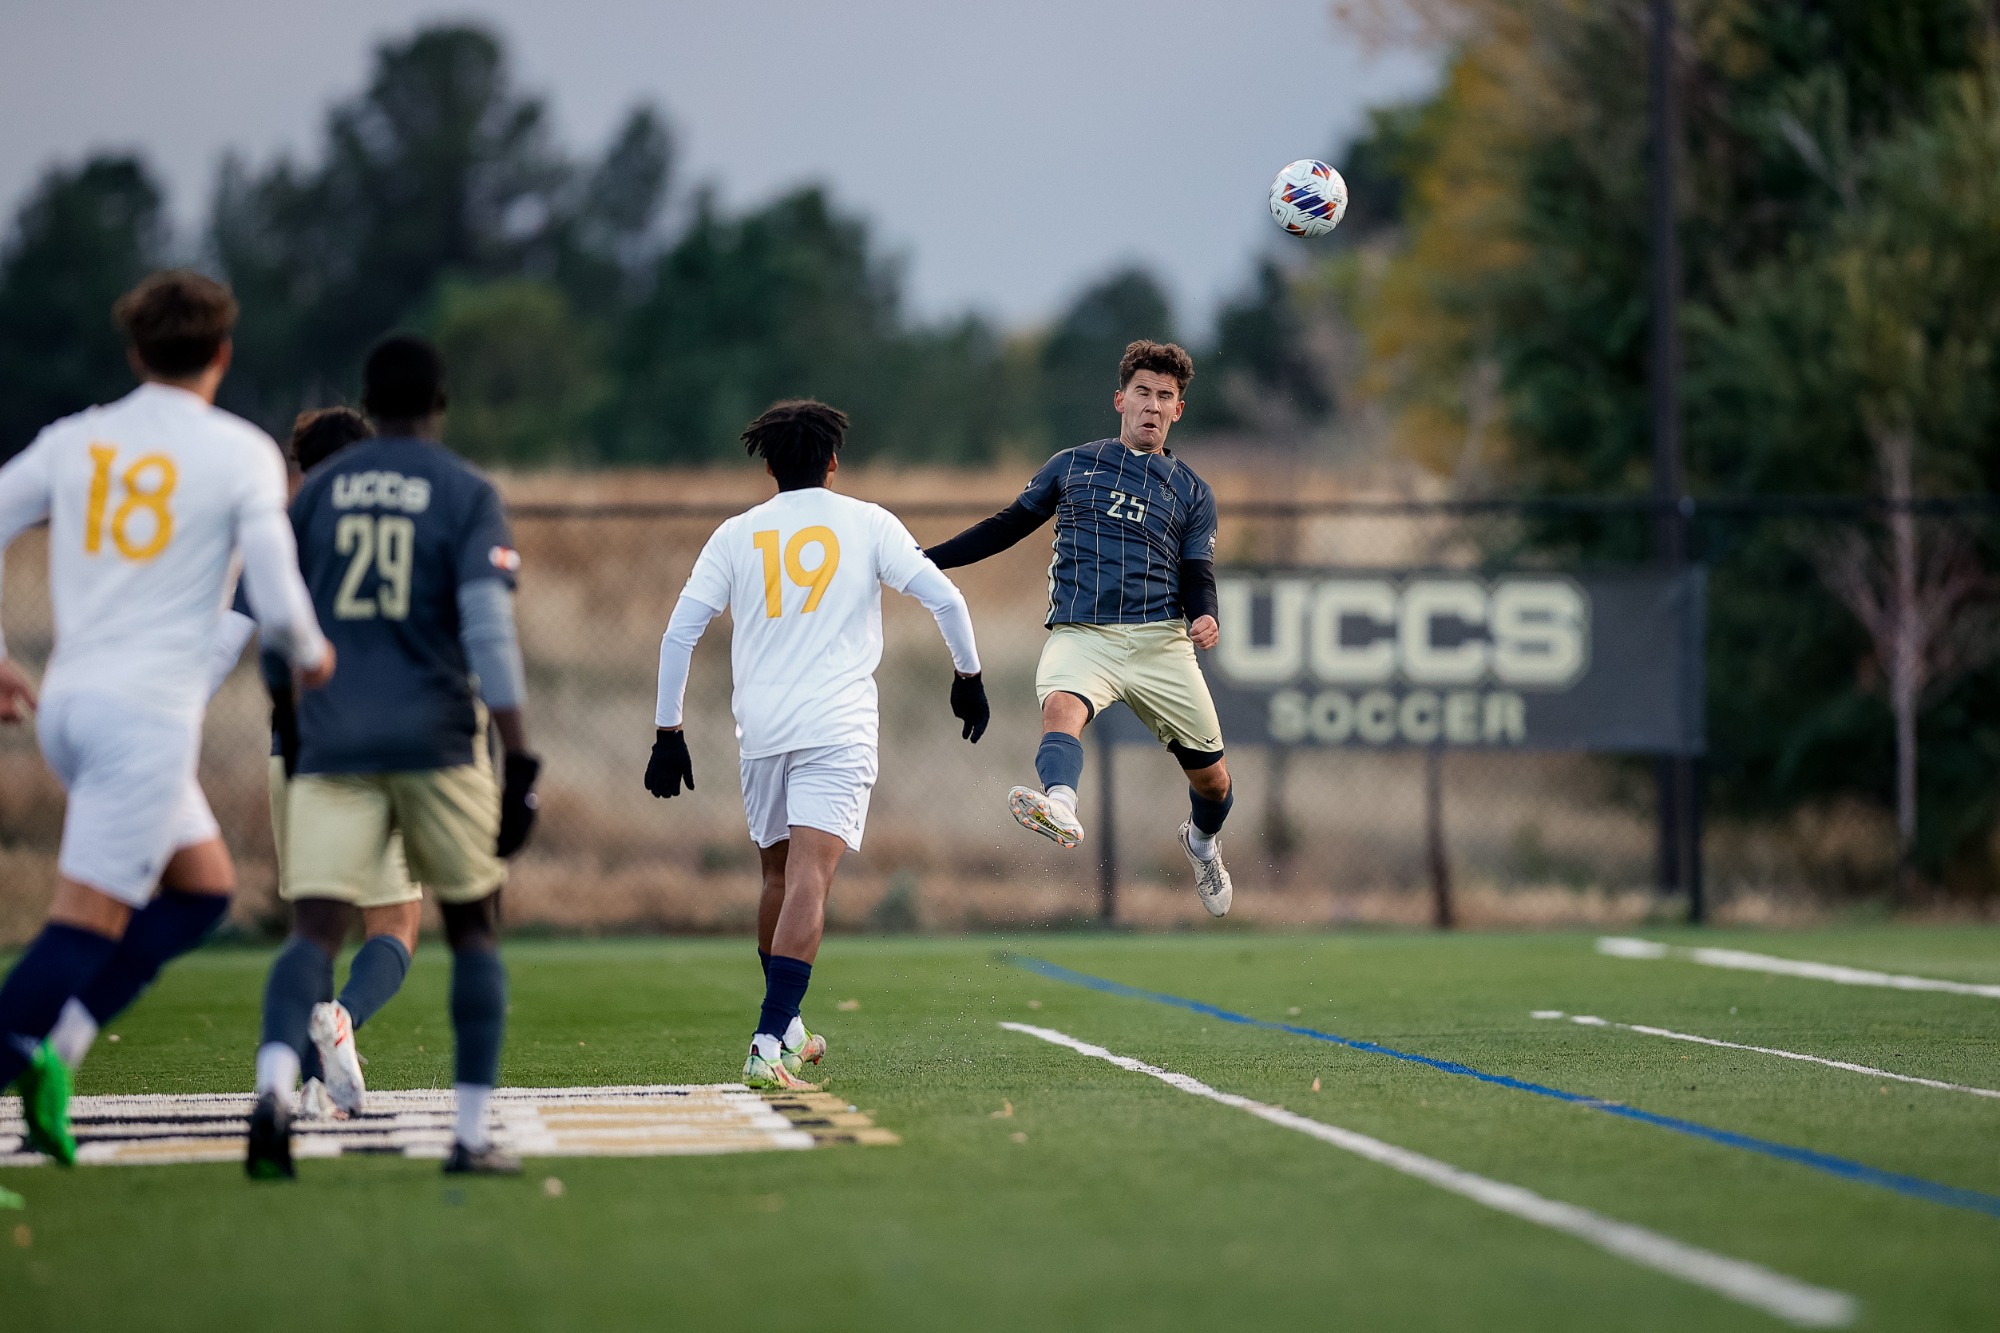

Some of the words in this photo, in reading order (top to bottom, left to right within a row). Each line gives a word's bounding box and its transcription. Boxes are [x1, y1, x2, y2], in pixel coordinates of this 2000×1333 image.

[84, 443, 178, 561] 18
[332, 472, 431, 513] UCCS
[1107, 490, 1145, 522] 25
[334, 514, 415, 621] 29
[753, 525, 840, 618] 19
[1217, 576, 1588, 685] UCCS
[1270, 691, 1527, 744] SOCCER
